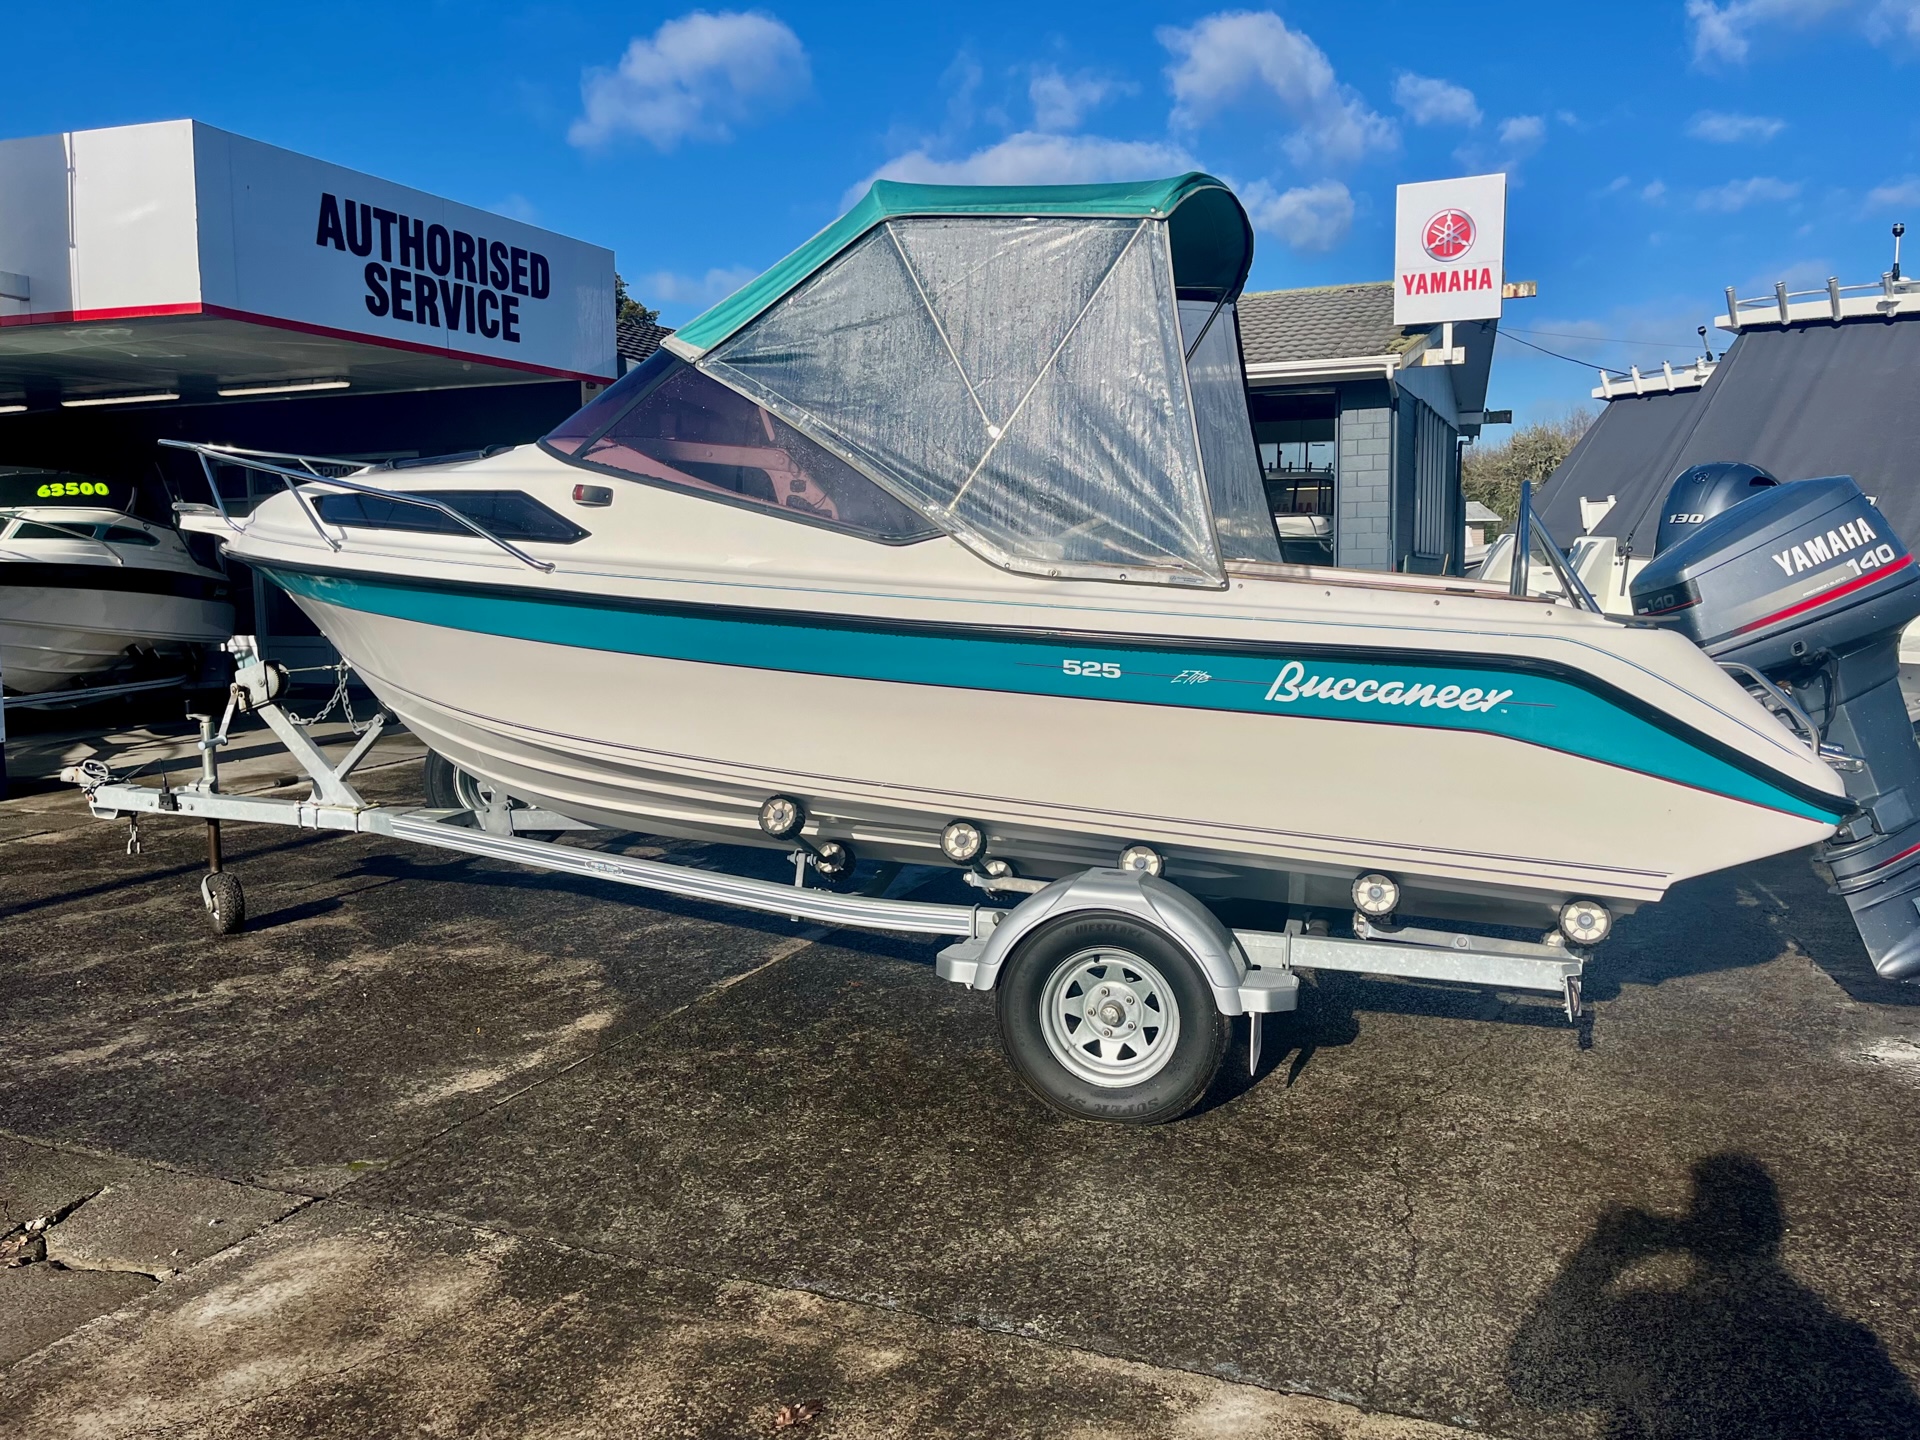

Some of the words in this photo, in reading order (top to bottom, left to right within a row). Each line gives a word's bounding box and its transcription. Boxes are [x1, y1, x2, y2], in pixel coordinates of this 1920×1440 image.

[316, 192, 550, 301] AUTHORISED
[1402, 267, 1493, 297] YAMAHA
[364, 260, 522, 344] SERVICE
[37, 481, 110, 498] 63500
[1668, 513, 1705, 525] 130
[1771, 517, 1877, 577] YAMAHA
[1845, 543, 1895, 576] 140
[1647, 594, 1675, 611] 140
[1062, 659, 1121, 679] 525
[1264, 660, 1513, 713] Buccaneer
